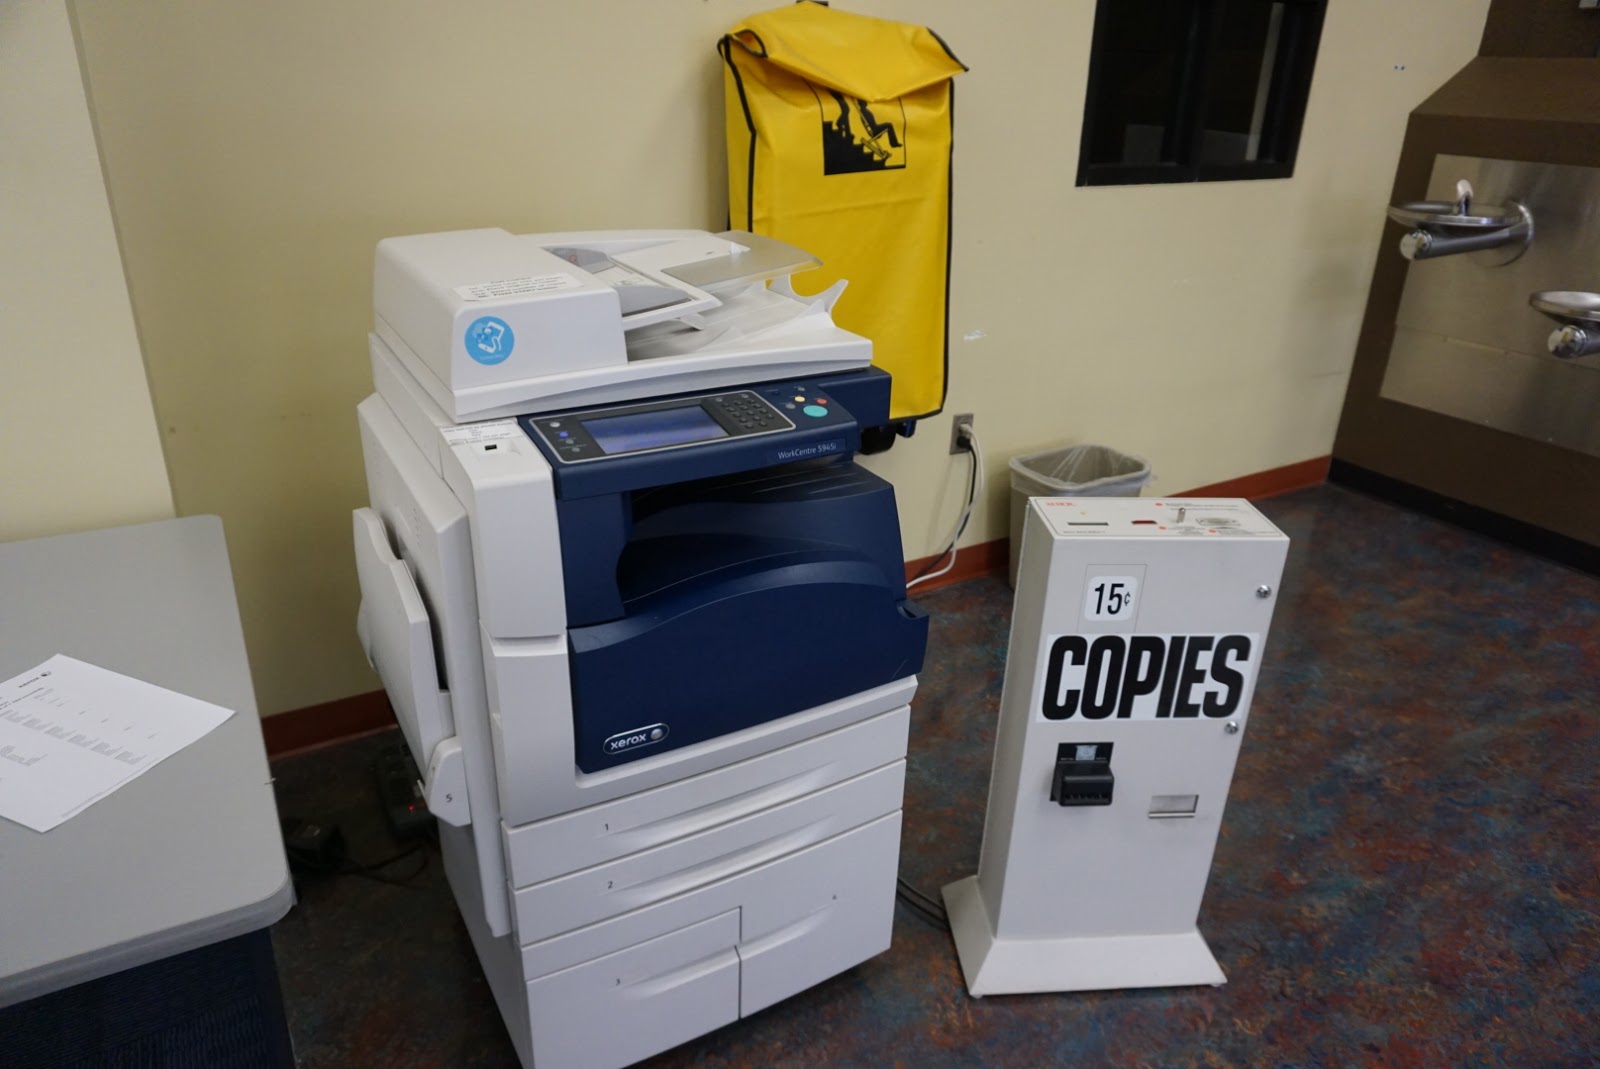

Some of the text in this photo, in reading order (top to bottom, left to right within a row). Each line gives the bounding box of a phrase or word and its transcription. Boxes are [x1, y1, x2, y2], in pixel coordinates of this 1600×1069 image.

[778, 442, 837, 459] WorkCentre 5945i
[1042, 635, 1251, 720] COPIES
[610, 733, 647, 750] xerox
[604, 823, 609, 831] 1
[608, 881, 613, 890] 2
